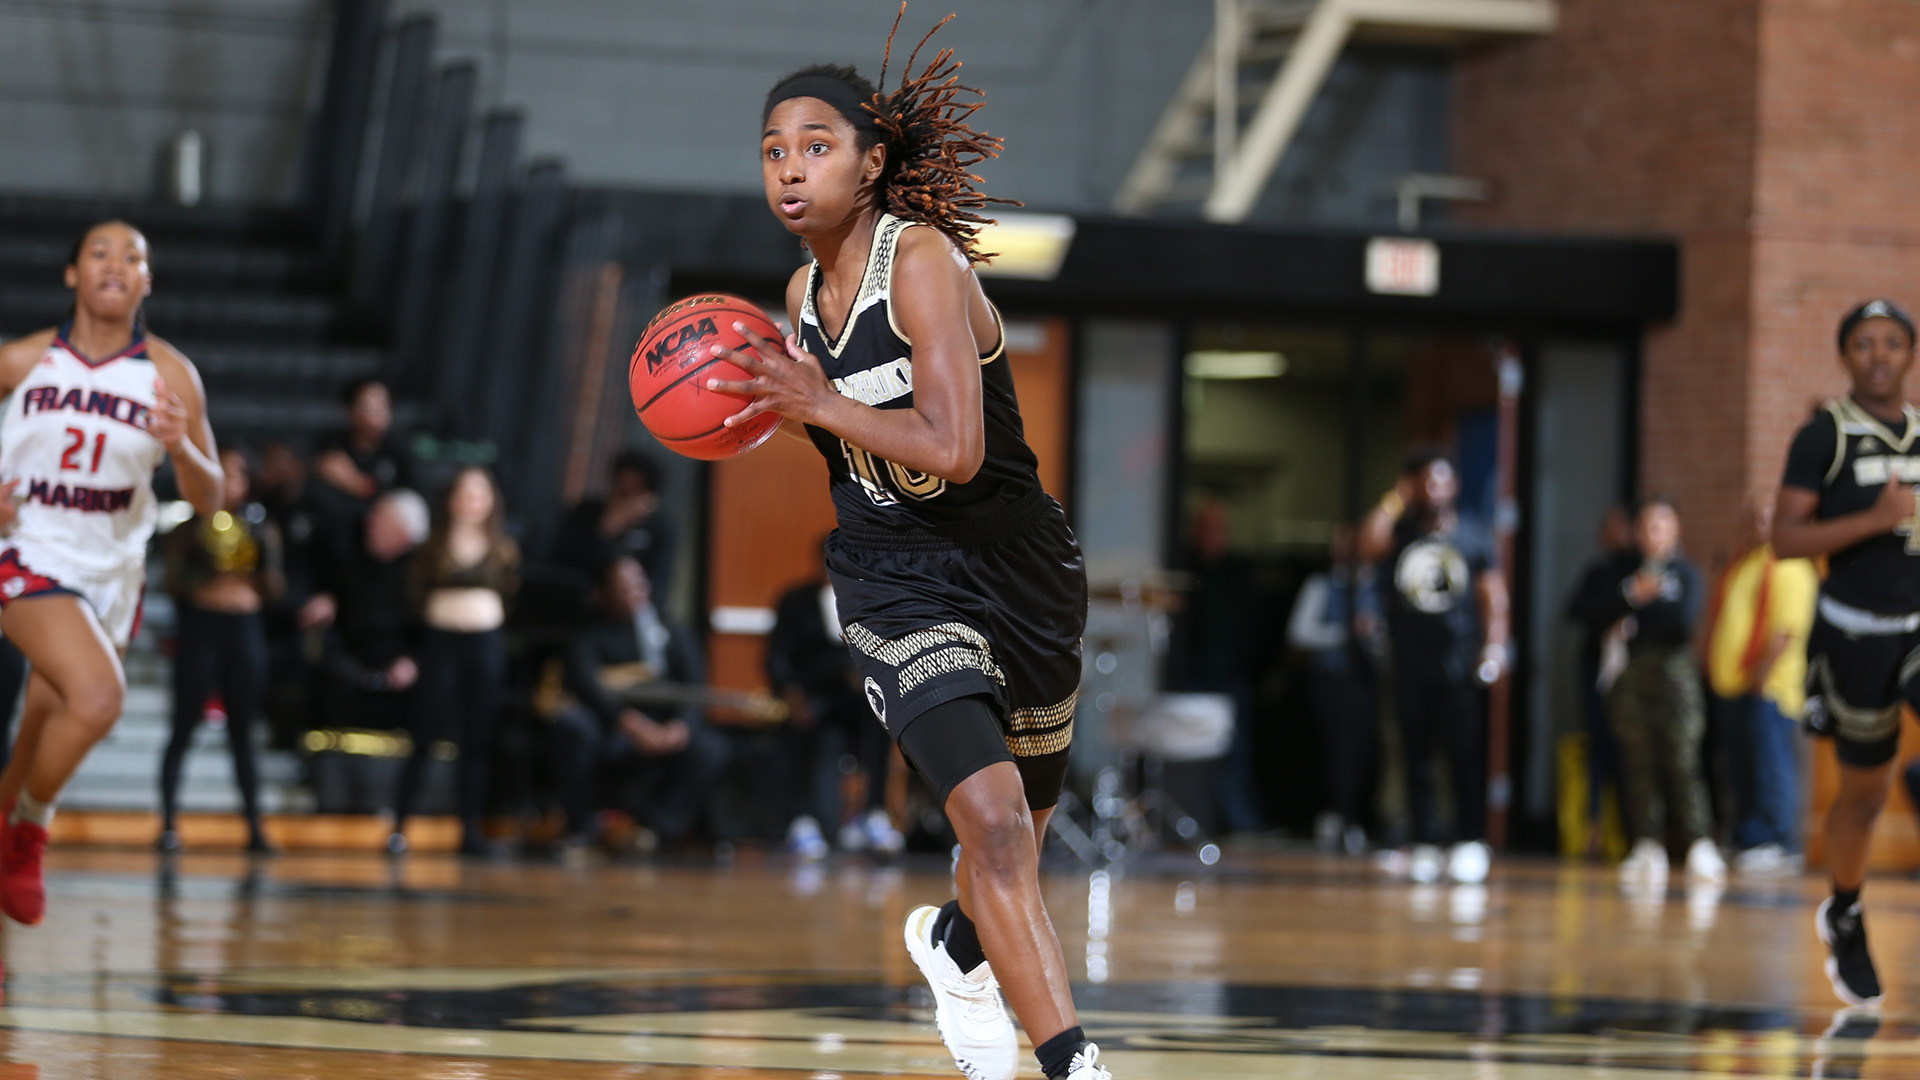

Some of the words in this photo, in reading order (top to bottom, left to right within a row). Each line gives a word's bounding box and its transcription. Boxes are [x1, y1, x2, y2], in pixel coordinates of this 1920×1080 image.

[645, 317, 719, 375] NCAA
[60, 427, 106, 474] 21
[26, 478, 135, 513] MARION
